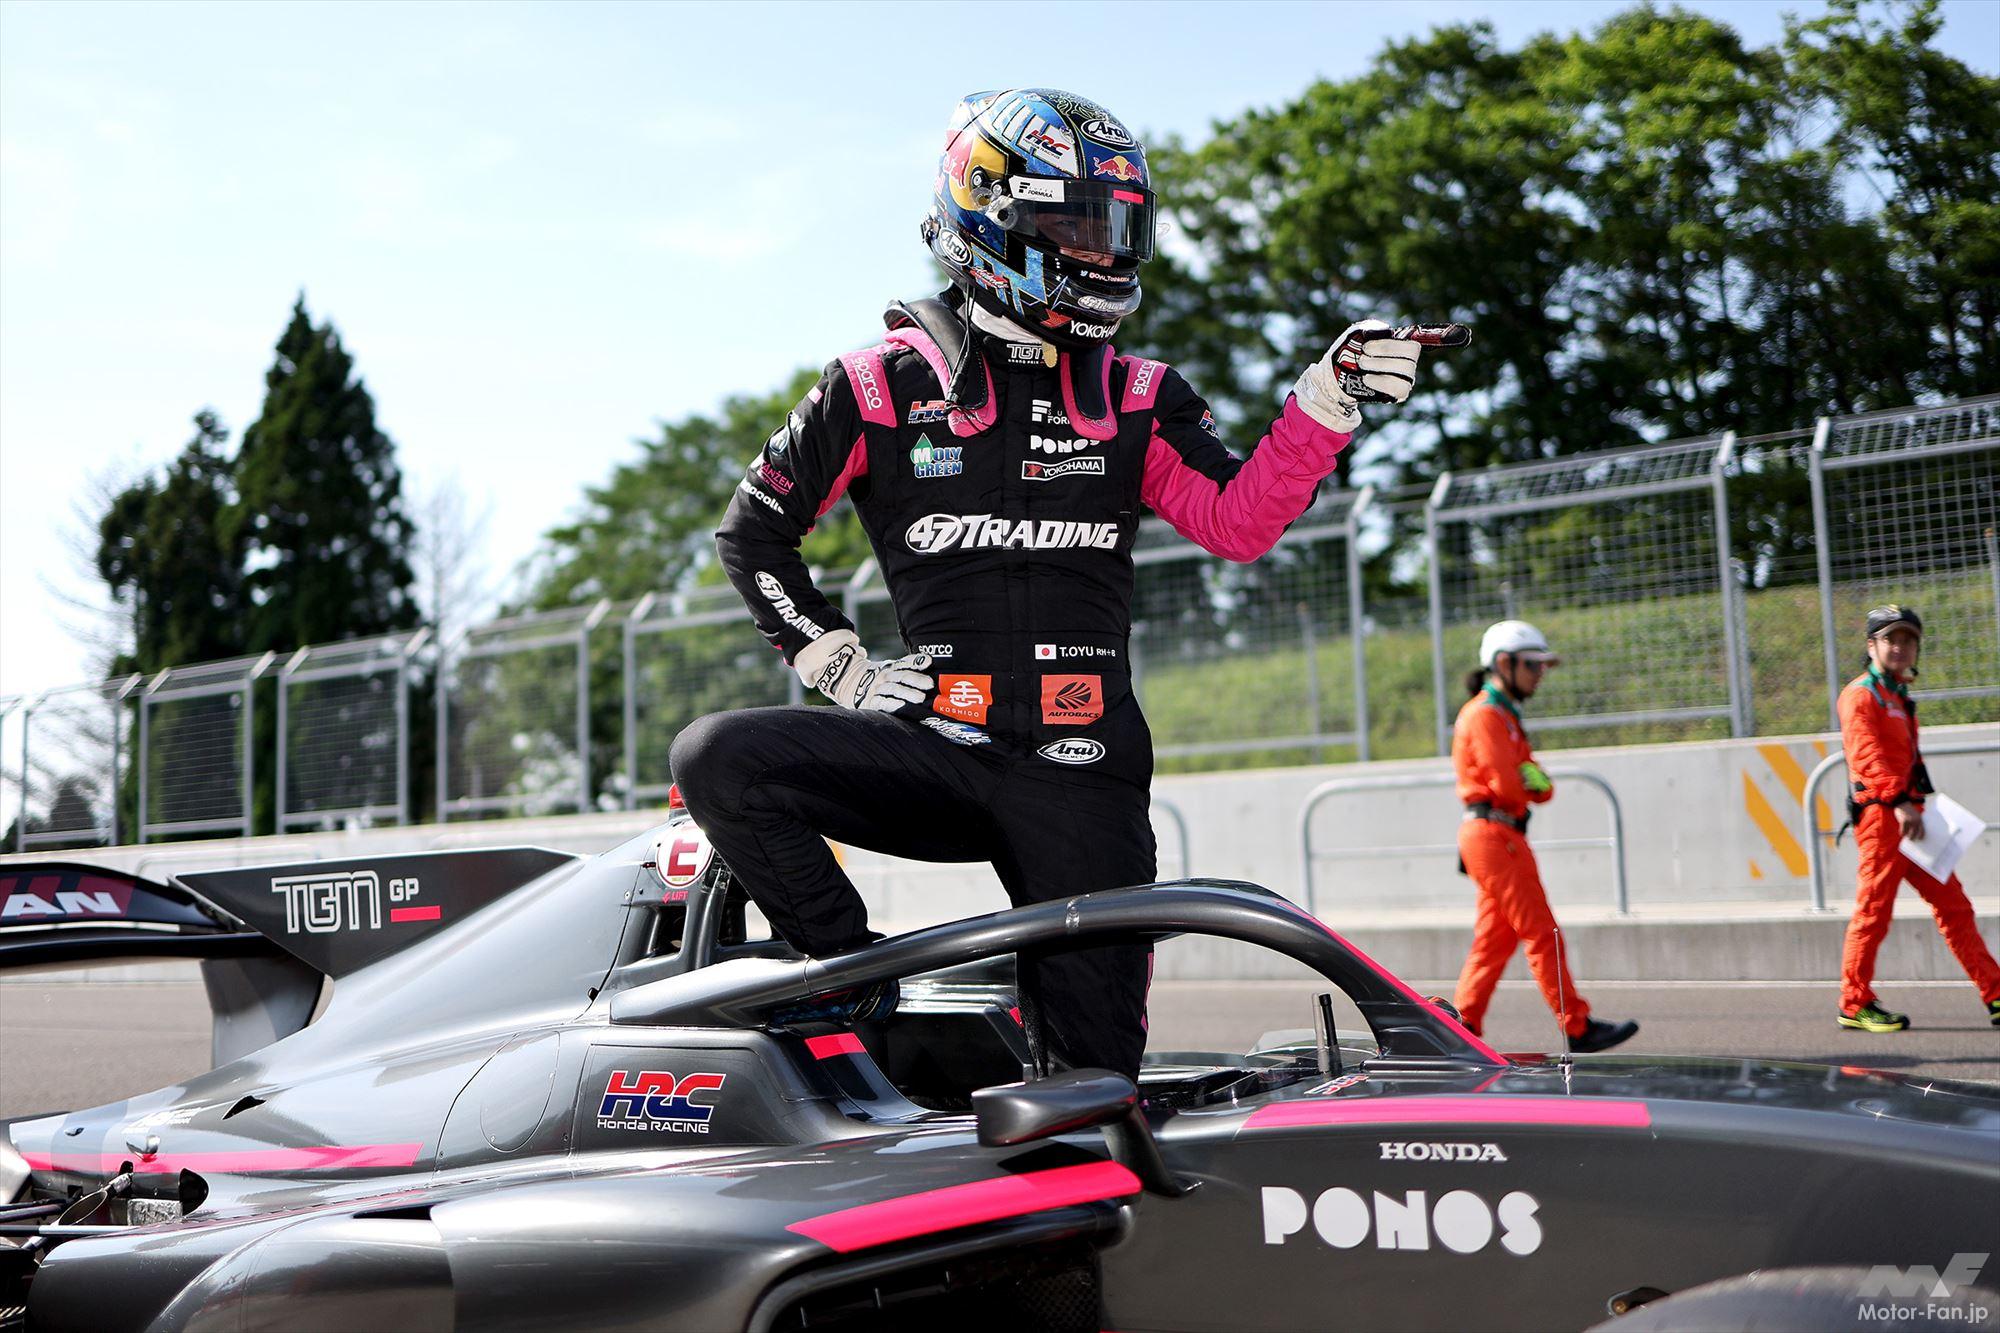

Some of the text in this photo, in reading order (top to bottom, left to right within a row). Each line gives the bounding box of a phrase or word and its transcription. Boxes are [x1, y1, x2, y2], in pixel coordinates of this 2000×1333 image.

[1025, 130, 1070, 157] HRC
[854, 356, 882, 408] sparco
[913, 446, 963, 463] MOLY
[914, 460, 963, 479] GREEN
[1042, 460, 1101, 477] YOKOHAMA
[918, 644, 953, 656] sparco
[1059, 646, 1094, 657] T.OYU
[939, 706, 980, 717] KOSHIDO
[1047, 711, 1101, 719] AUTOBACS
[1052, 743, 1096, 755] Arai
[390, 878, 419, 902] GP
[671, 890, 689, 900] LIFT
[597, 1070, 727, 1122] HRC
[597, 1118, 709, 1134] Honda RACING
[1379, 1142, 1507, 1162] HONDA
[1261, 1186, 1544, 1257] PONOS
